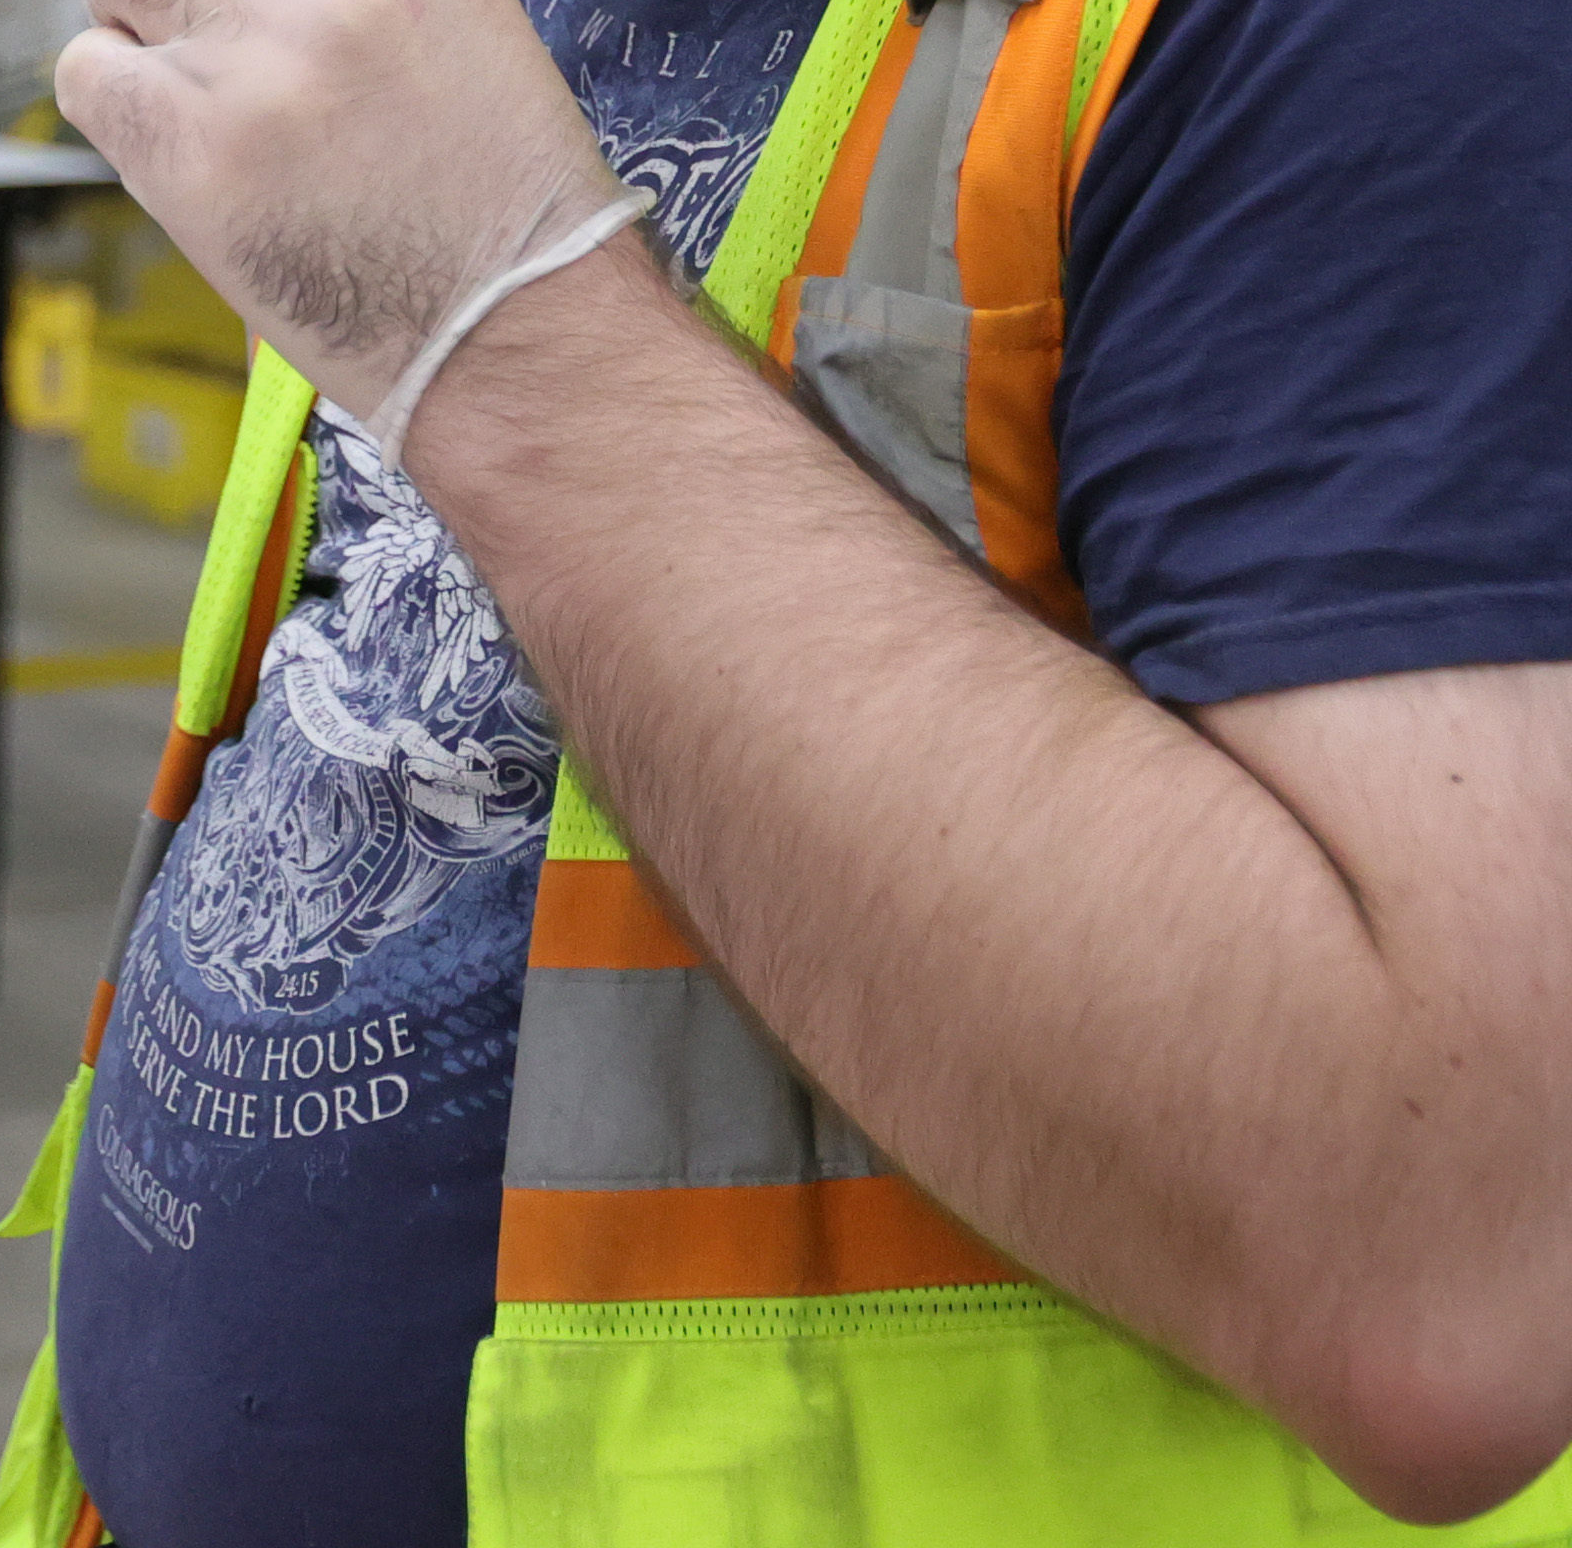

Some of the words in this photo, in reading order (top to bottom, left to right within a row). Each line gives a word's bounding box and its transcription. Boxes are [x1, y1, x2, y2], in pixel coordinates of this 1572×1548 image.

[577, 8, 724, 79] WILL
[150, 984, 202, 1058] AND
[204, 1029, 256, 1078] MY
[260, 1012, 416, 1082] HOUSE
[274, 970, 320, 998] 24:15
[128, 1010, 188, 1114] SERVE
[192, 1080, 258, 1139] THE
[273, 1074, 409, 1140] LORD
[96, 1103, 202, 1251] COURAGEOUS
